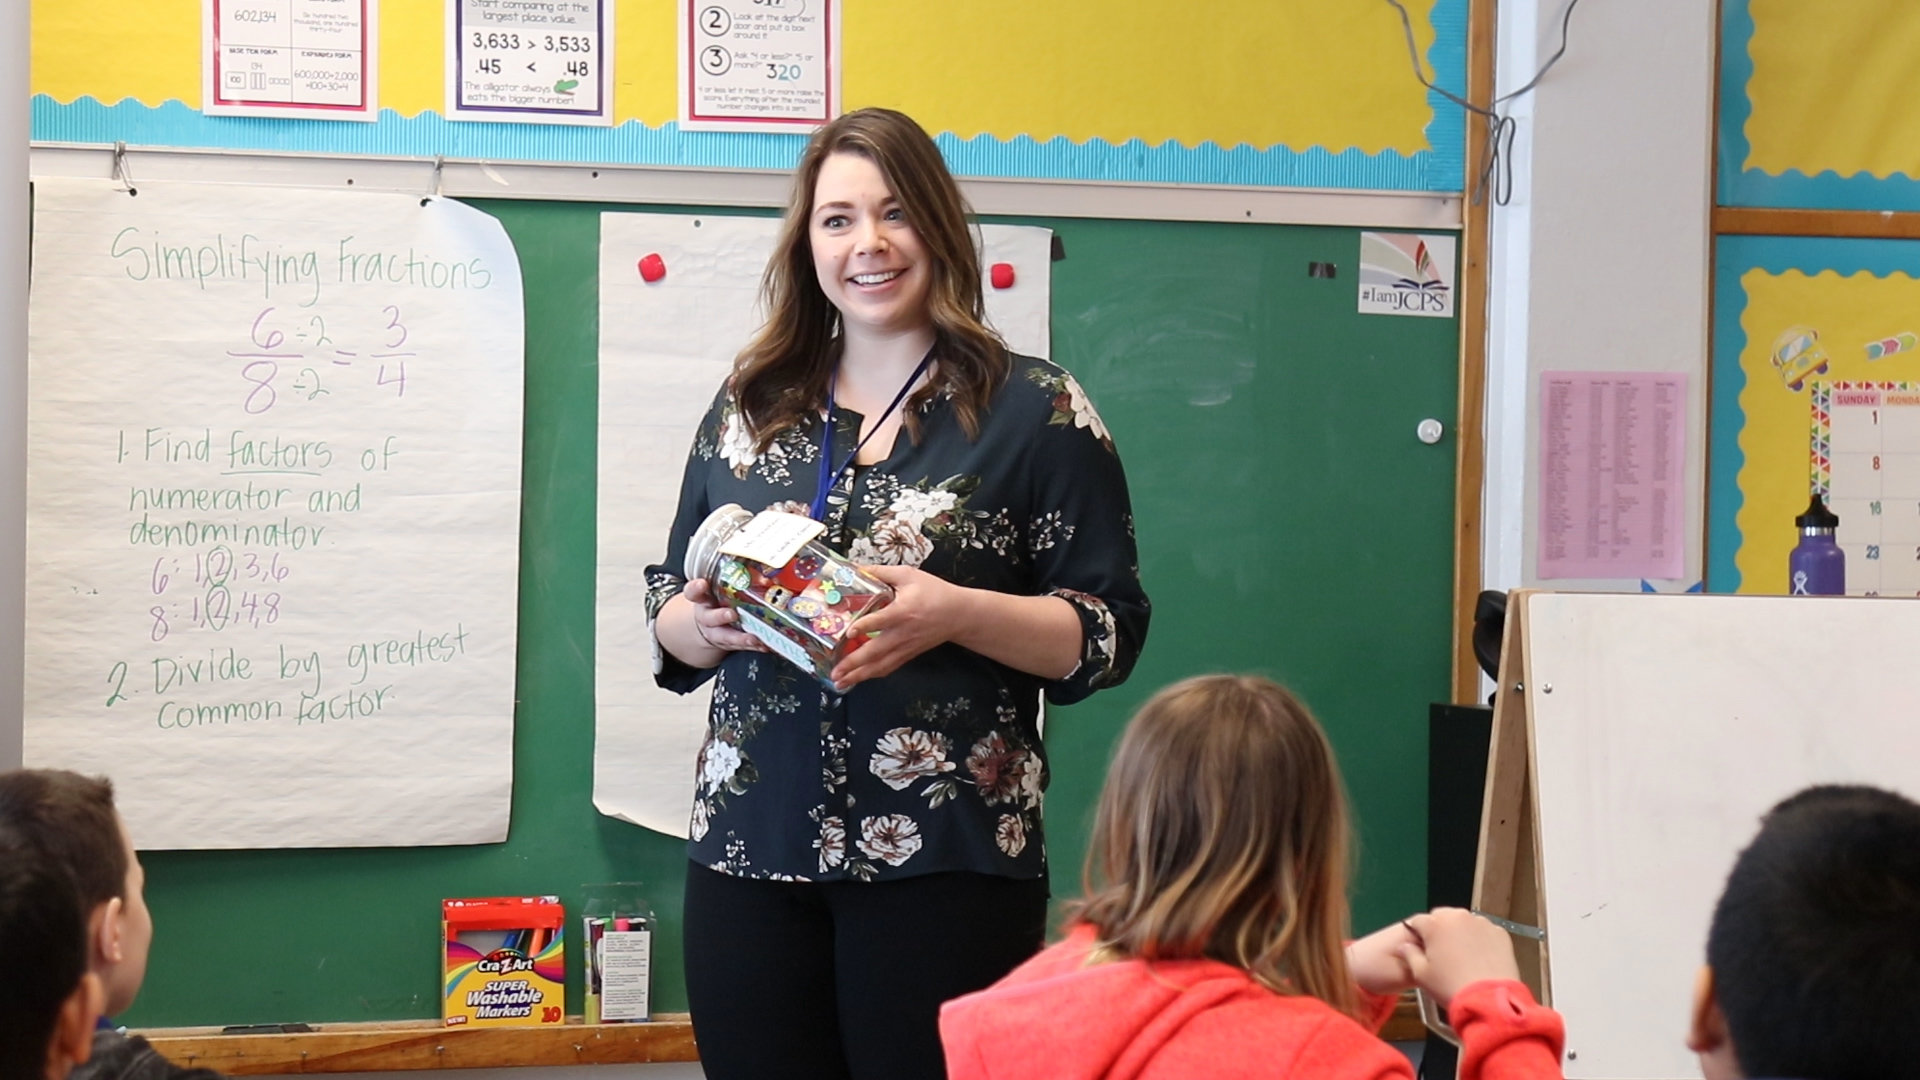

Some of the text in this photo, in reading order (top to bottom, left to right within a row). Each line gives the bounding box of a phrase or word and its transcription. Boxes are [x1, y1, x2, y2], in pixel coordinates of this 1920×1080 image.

[502, 0, 555, 13] comparing
[556, 3, 569, 12] at
[572, 3, 590, 12] the
[483, 10, 519, 23] largest
[521, 13, 548, 24] place
[709, 10, 722, 28] 2
[472, 32, 591, 54] 3,633 > 3,533
[475, 58, 590, 77] .45 < .48
[709, 49, 723, 68] 3
[766, 63, 802, 81] 320
[464, 80, 552, 95] The alligator always
[467, 92, 489, 102] eats
[490, 93, 507, 103] the
[508, 94, 536, 105] bigger
[111, 226, 492, 308] Simplifying Fractions
[251, 306, 285, 350] 6
[381, 304, 408, 349] 3
[241, 360, 279, 415] 8
[376, 360, 407, 398] 4
[1837, 395, 1877, 405] SUNDAY
[1872, 409, 1878, 425] 1
[144, 426, 210, 463] Find
[227, 429, 333, 469] factors
[360, 435, 400, 472] of
[1872, 455, 1881, 471] 8
[129, 480, 362, 513] numerator and
[150, 555, 181, 595] 6:
[150, 602, 181, 642] 8:
[151, 647, 253, 695] Divide
[279, 643, 322, 698] by
[347, 622, 471, 686] greatest
[157, 695, 284, 730] common
[485, 980, 529, 992] SUPER
[466, 988, 543, 1007] Washable
[475, 1004, 532, 1018] Markers
[541, 1006, 562, 1023] 10
